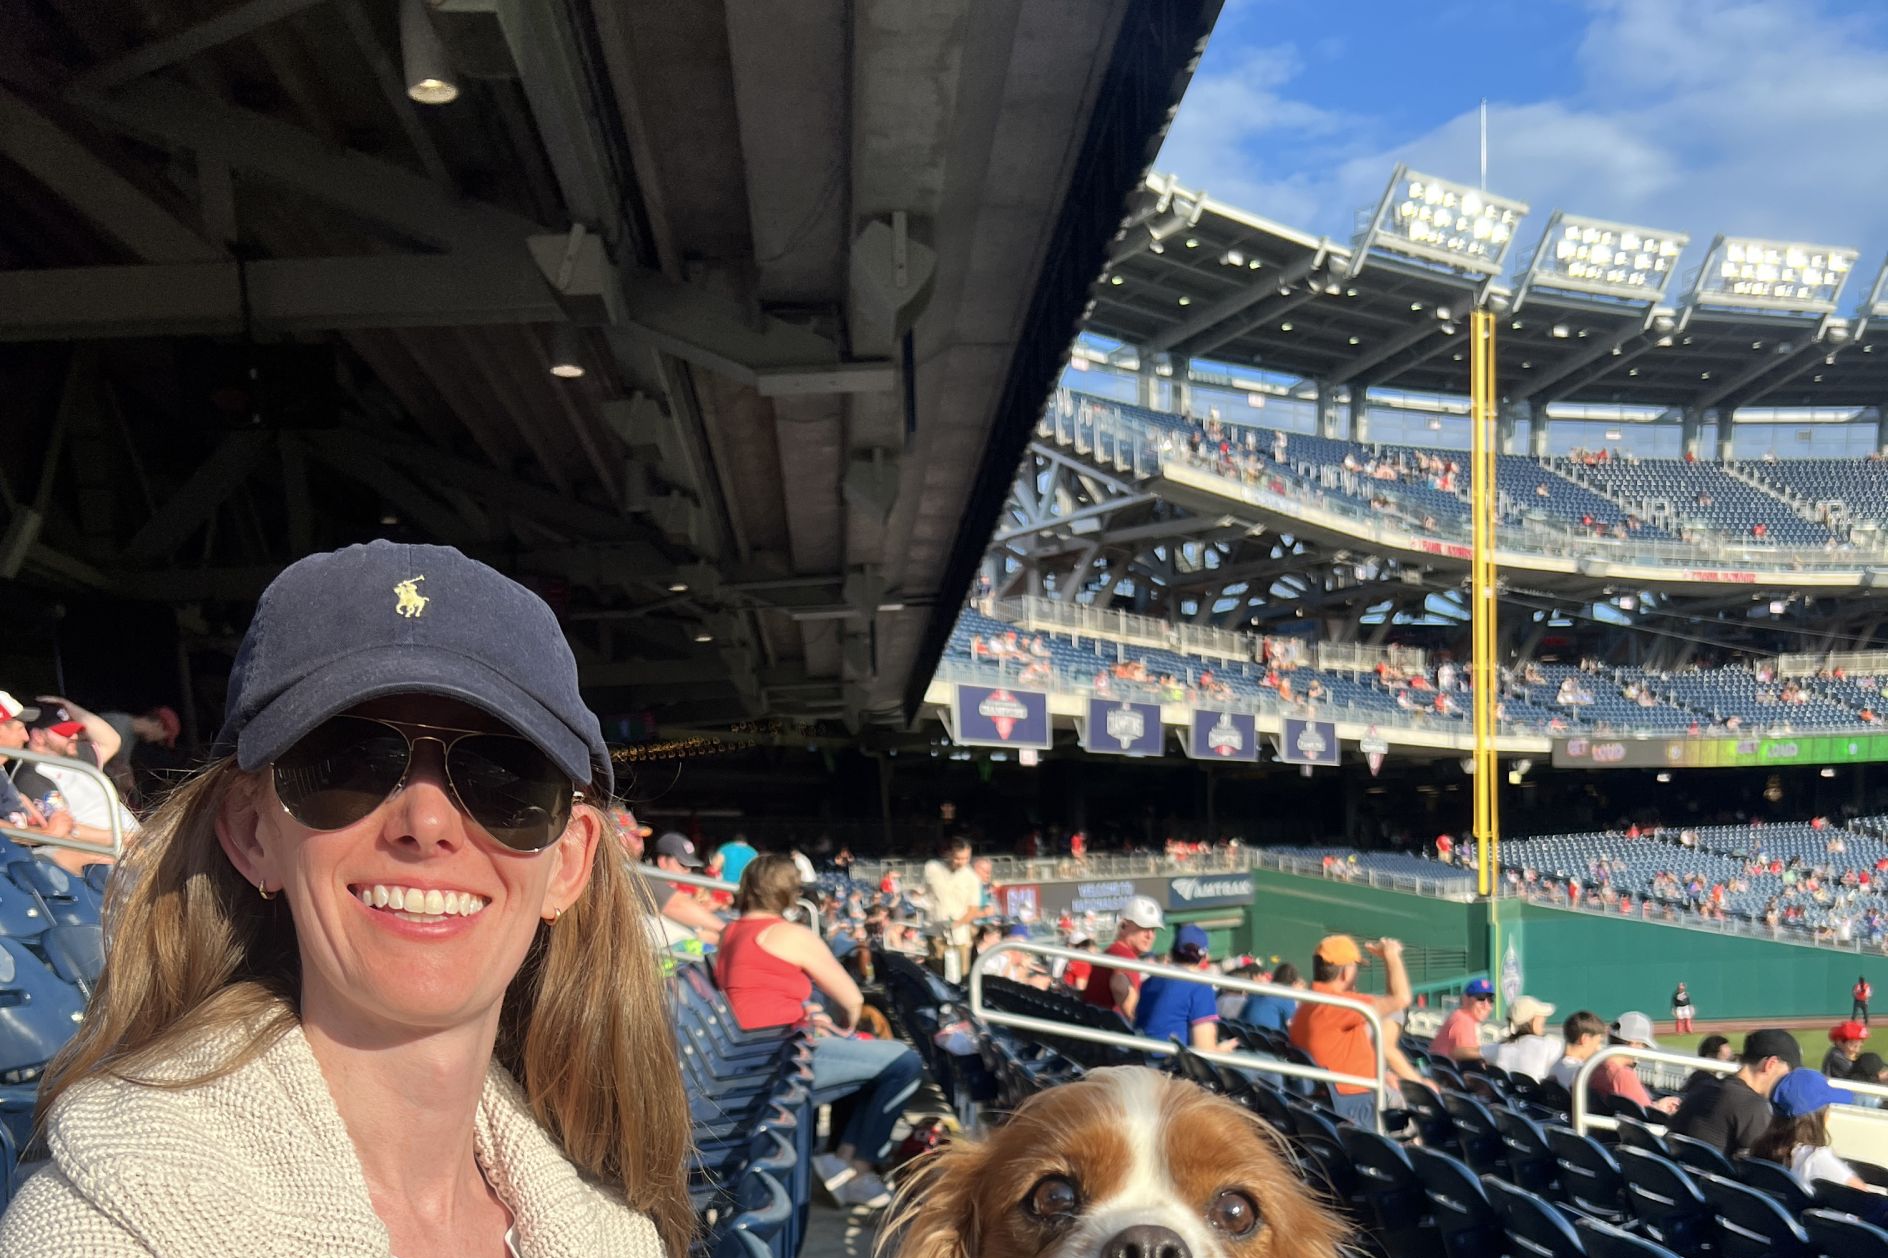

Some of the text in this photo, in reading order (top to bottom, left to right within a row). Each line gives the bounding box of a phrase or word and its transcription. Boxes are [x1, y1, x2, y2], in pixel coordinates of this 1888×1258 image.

[1567, 739, 1626, 761] GET LOUD
[1078, 883, 1118, 897] WELCOME
[1194, 880, 1251, 898] AMTRAK
